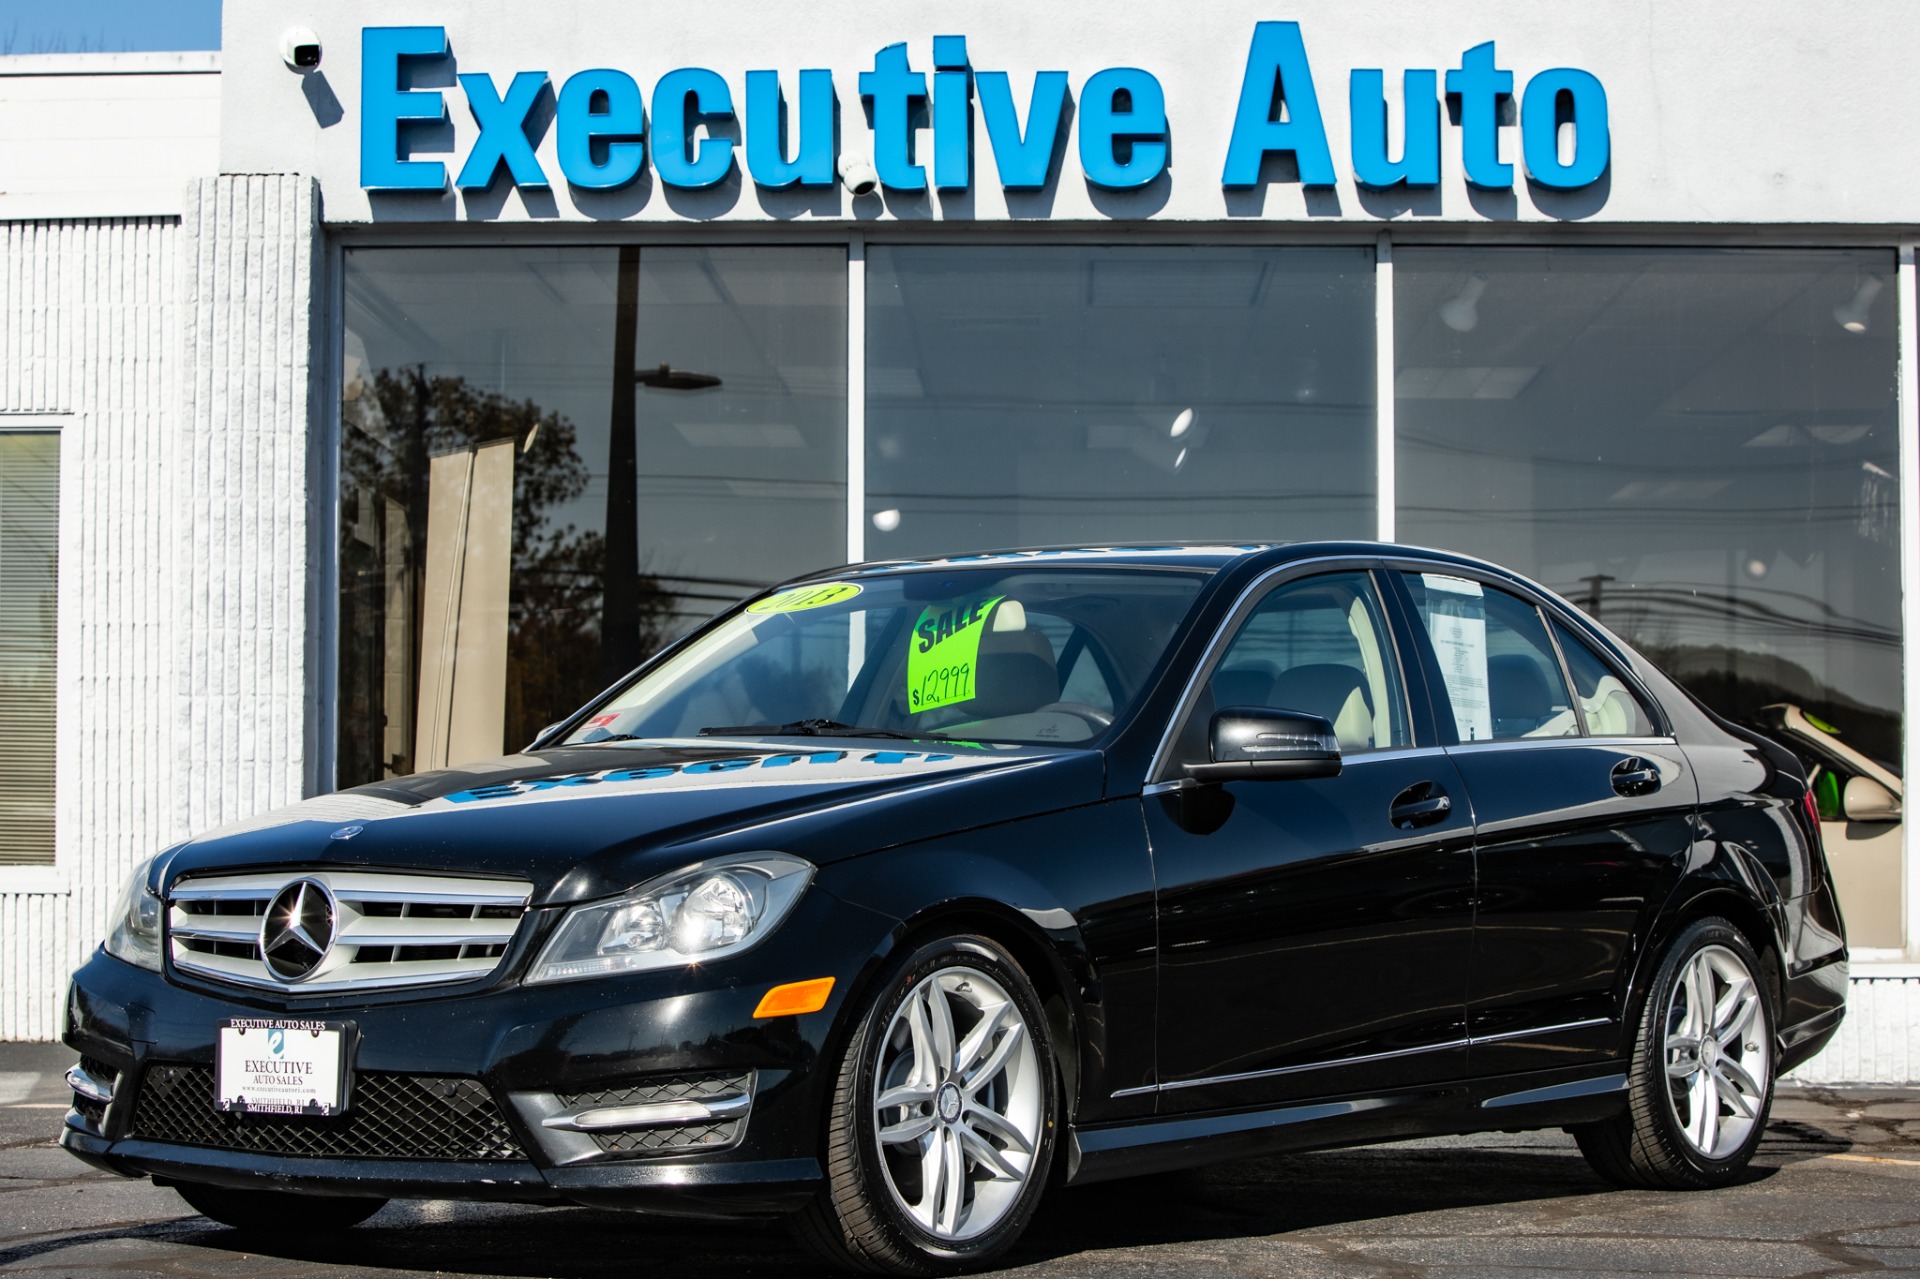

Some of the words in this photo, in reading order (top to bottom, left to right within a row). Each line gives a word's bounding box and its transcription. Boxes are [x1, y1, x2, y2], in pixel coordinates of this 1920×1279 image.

[360, 26, 1167, 192] Executive
[1221, 21, 1611, 190] Auto
[917, 599, 986, 654] SALE
[230, 1019, 273, 1029] EXECUTIVE
[275, 1020, 298, 1029] AUTO
[300, 1021, 325, 1030] SALES
[245, 1060, 313, 1075] EXECUTIVE
[253, 1075, 275, 1085] AUTO
[277, 1076, 303, 1086] SALES
[242, 1086, 316, 1094] www.executiveautori.com
[247, 1104, 293, 1114] SMITHFIELD,
[294, 1106, 302, 1114] RI
